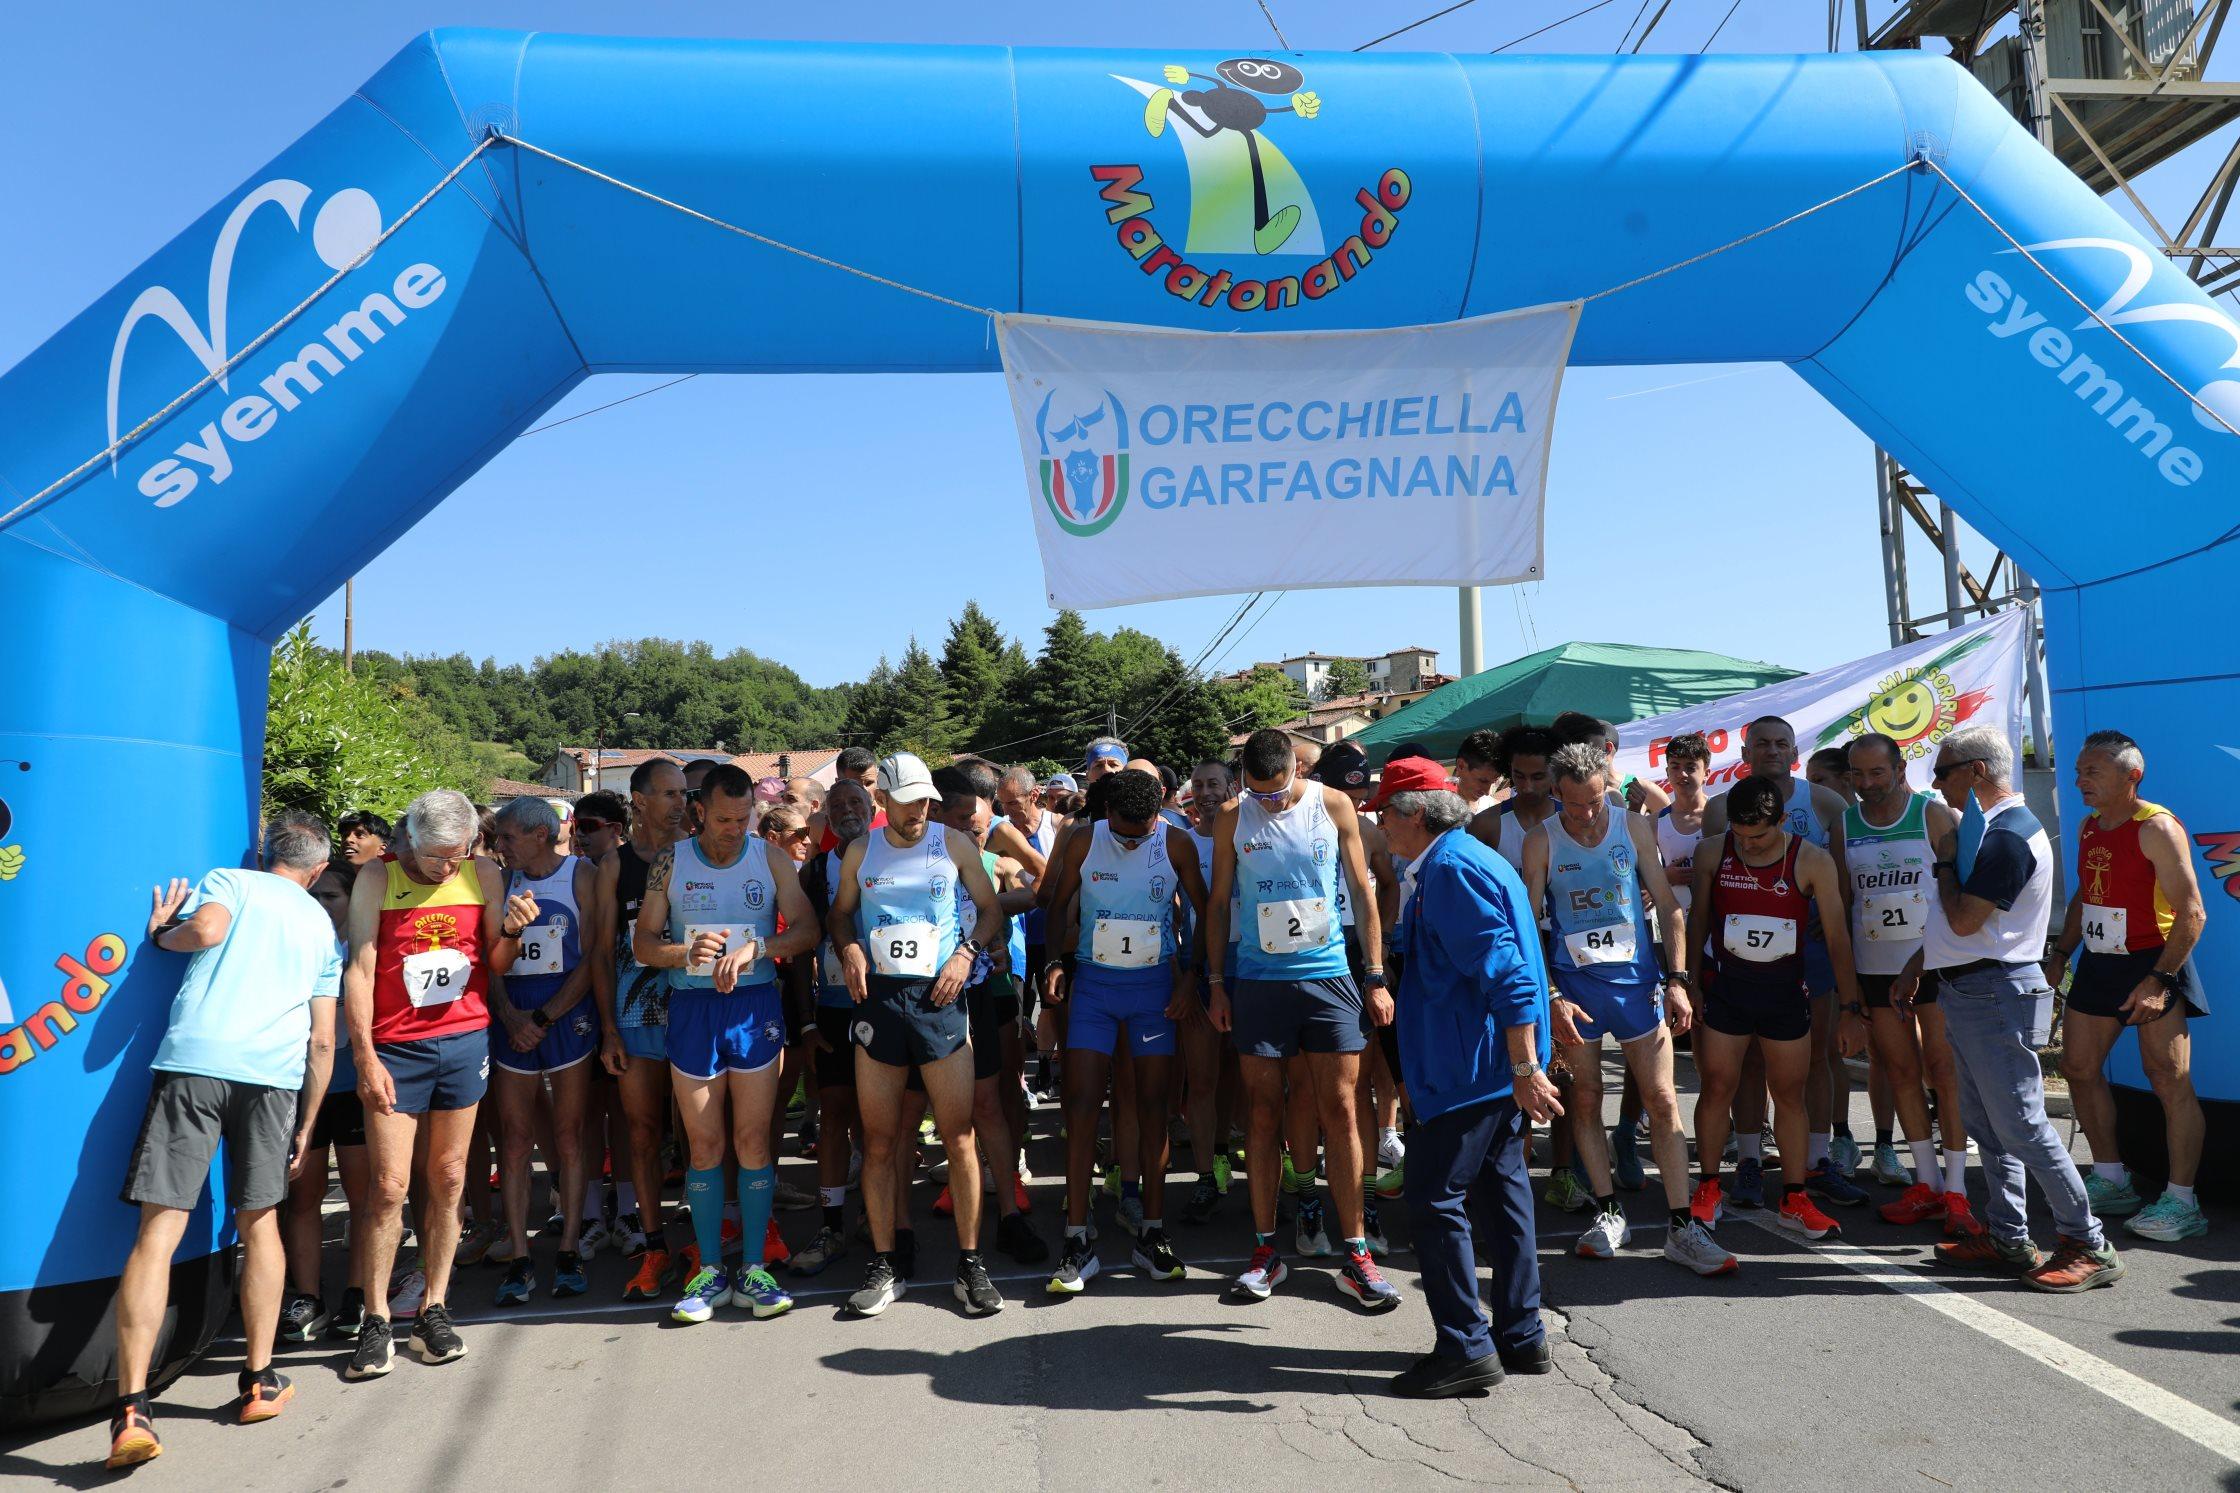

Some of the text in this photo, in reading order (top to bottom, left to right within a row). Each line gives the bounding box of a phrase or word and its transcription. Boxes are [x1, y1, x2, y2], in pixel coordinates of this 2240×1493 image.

[1089, 164, 1412, 312] Maratonando
[138, 262, 447, 508] syemme
[1965, 270, 2203, 486] syemme
[1139, 391, 1526, 446] ORECCHIELLA
[1140, 455, 1519, 510] GARFAGNANA
[1277, 880, 1323, 890] PRORUN
[1858, 870, 1922, 889] Cetilar
[1882, 908, 1908, 927] 21
[1288, 918, 1302, 937] 2
[2086, 921, 2104, 940] 44
[1121, 937, 1132, 954] 1
[1587, 931, 1614, 949] 64
[1747, 930, 1774, 948] 57
[890, 940, 918, 958] 63
[421, 967, 450, 990] 78
